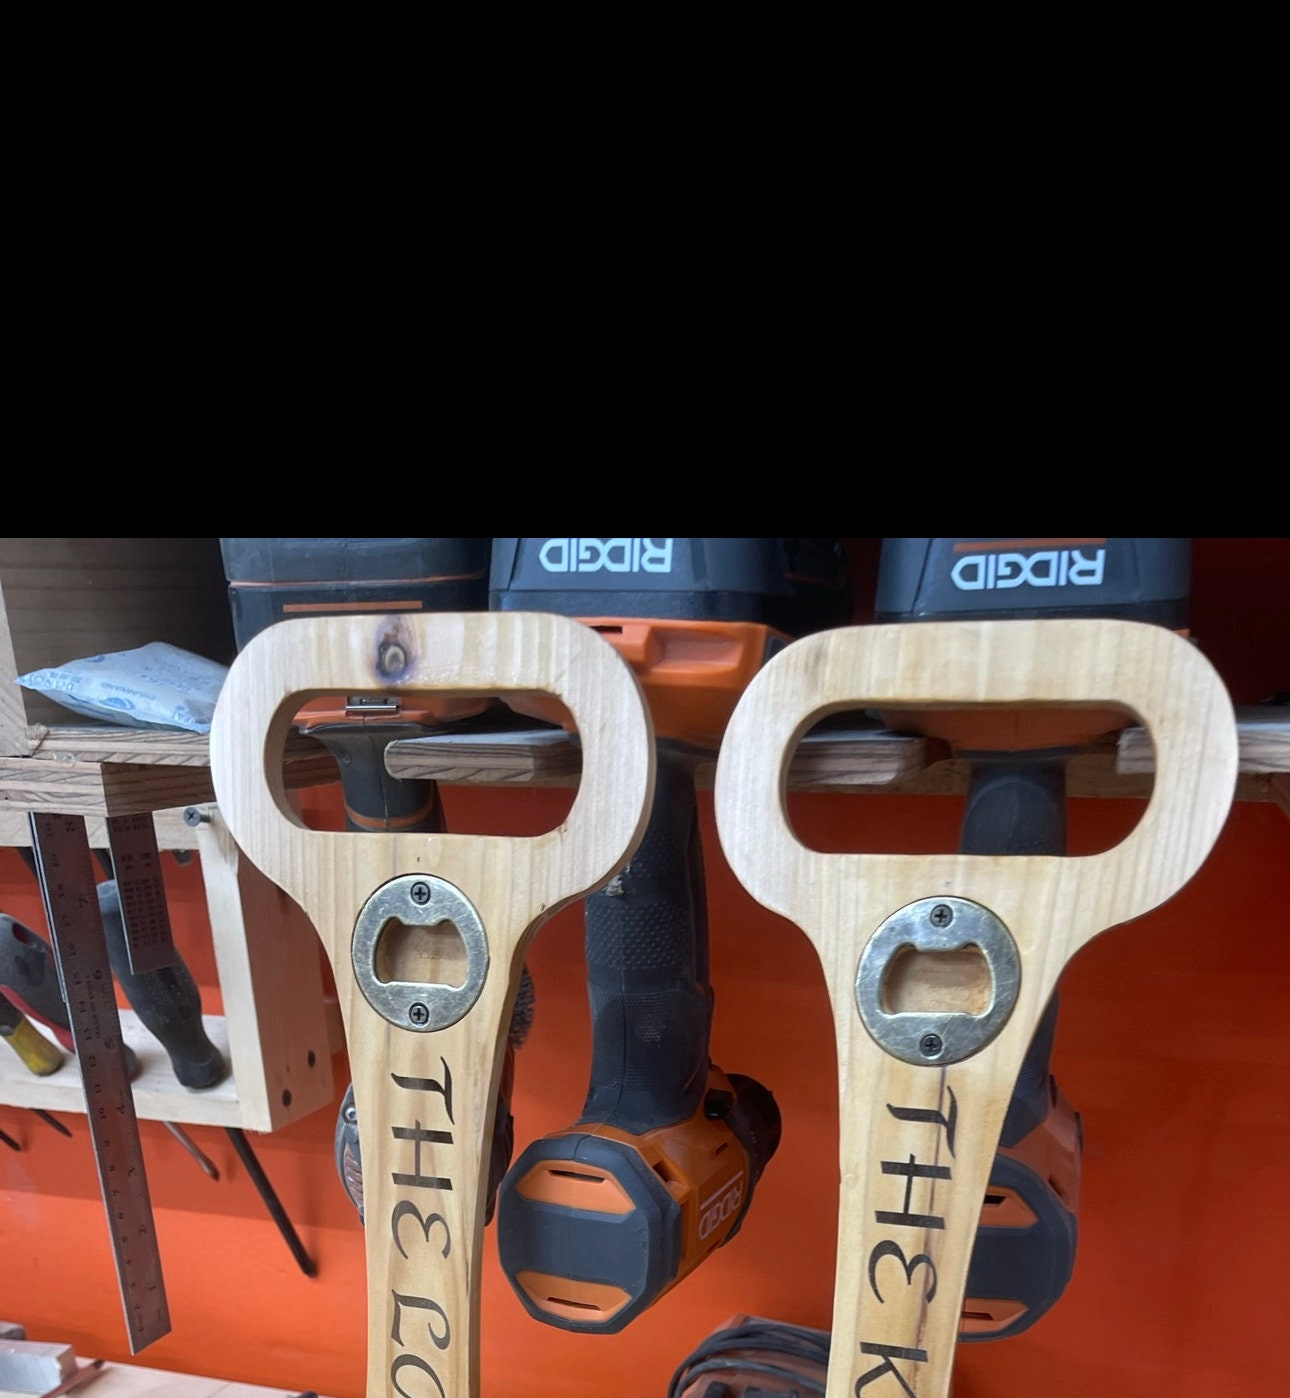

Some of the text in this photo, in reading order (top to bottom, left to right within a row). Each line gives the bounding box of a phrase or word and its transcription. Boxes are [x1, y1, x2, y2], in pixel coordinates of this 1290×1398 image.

[539, 538, 673, 573] RIDGID
[951, 549, 1106, 590] RIDGID
[391, 1057, 455, 1259] THE
[868, 1085, 958, 1304] THE
